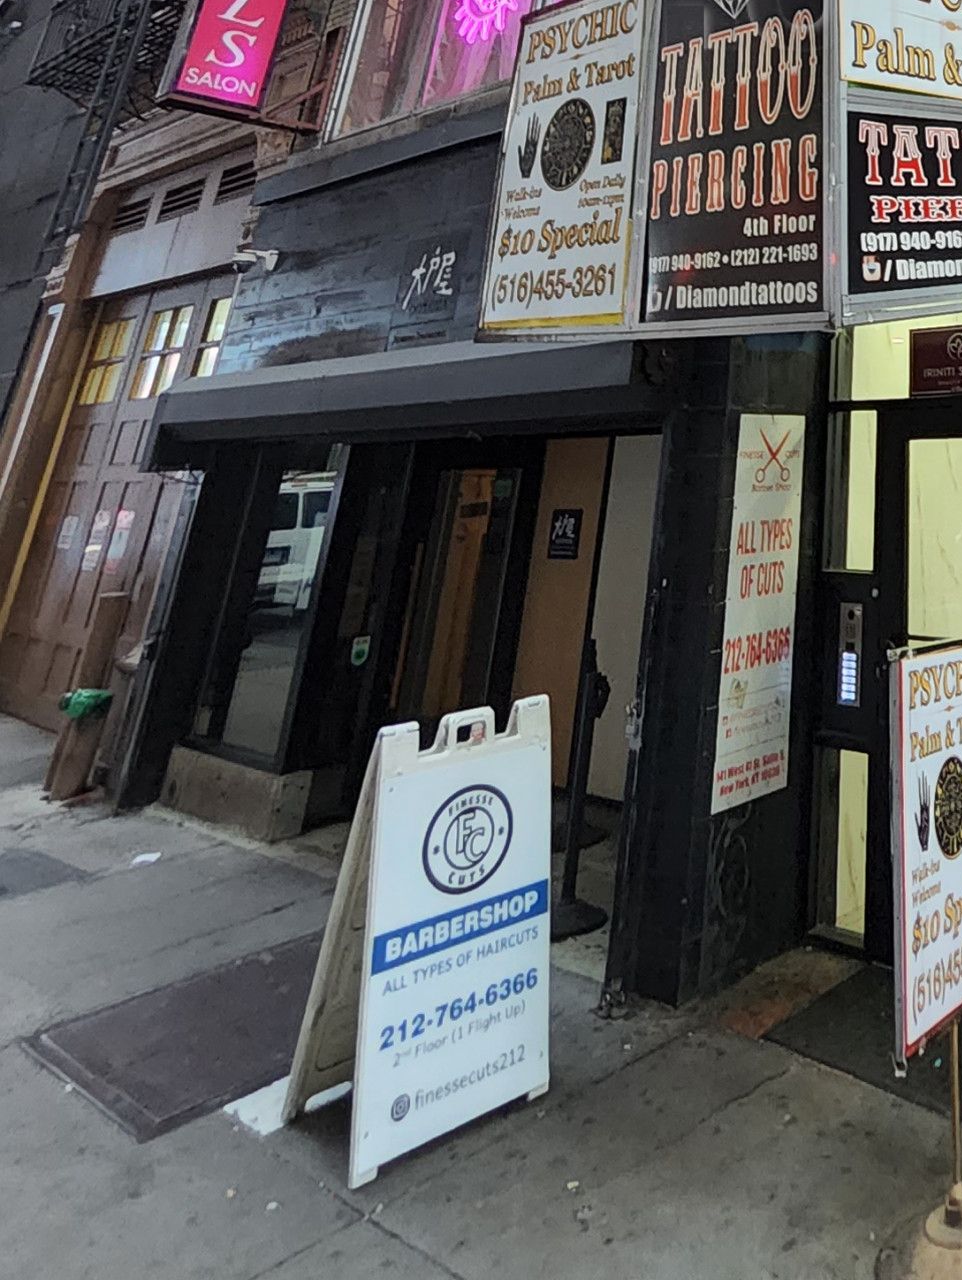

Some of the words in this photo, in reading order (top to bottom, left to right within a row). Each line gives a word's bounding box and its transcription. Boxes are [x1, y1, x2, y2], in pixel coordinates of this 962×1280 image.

[660, 8, 818, 145] TATTOO
[851, 20, 937, 81] Palm
[185, 68, 257, 98] SALON
[521, 73, 563, 106] Palm
[566, 66, 582, 93] &
[584, 52, 636, 89] Tarot
[650, 133, 818, 220] PIERCING
[498, 222, 536, 262] $10
[537, 206, 623, 260] Special
[742, 216, 769, 237] 4th
[773, 214, 817, 234] Floor
[859, 231, 898, 252] (917)
[671, 250, 721, 270] 940-9162
[730, 247, 760, 268] (212)
[761, 242, 818, 264] 221-1693
[491, 262, 617, 311] (516)455-3261
[676, 280, 818, 310] Diamondtattoos
[736, 521, 757, 556] ALL
[759, 518, 794, 553] TYPES
[739, 564, 756, 600] OF
[756, 560, 785, 597] CUTS
[910, 724, 943, 763] Palm
[945, 720, 956, 750] &
[448, 793, 495, 817] FINESSE
[384, 889, 540, 963] BARBERSHOP
[911, 909, 941, 963] $10
[381, 979, 408, 997] ALL
[412, 956, 453, 985] TYPES
[455, 951, 474, 968] OF
[476, 925, 540, 961] HAIRCUTS
[378, 966, 540, 1052] 212-764-6366
[414, 1035, 449, 1059] Floor
[450, 1025, 464, 1044] (1
[467, 1011, 501, 1036] Flight
[504, 999, 526, 1020] Up)
[414, 1043, 526, 1111] finessecuts212
